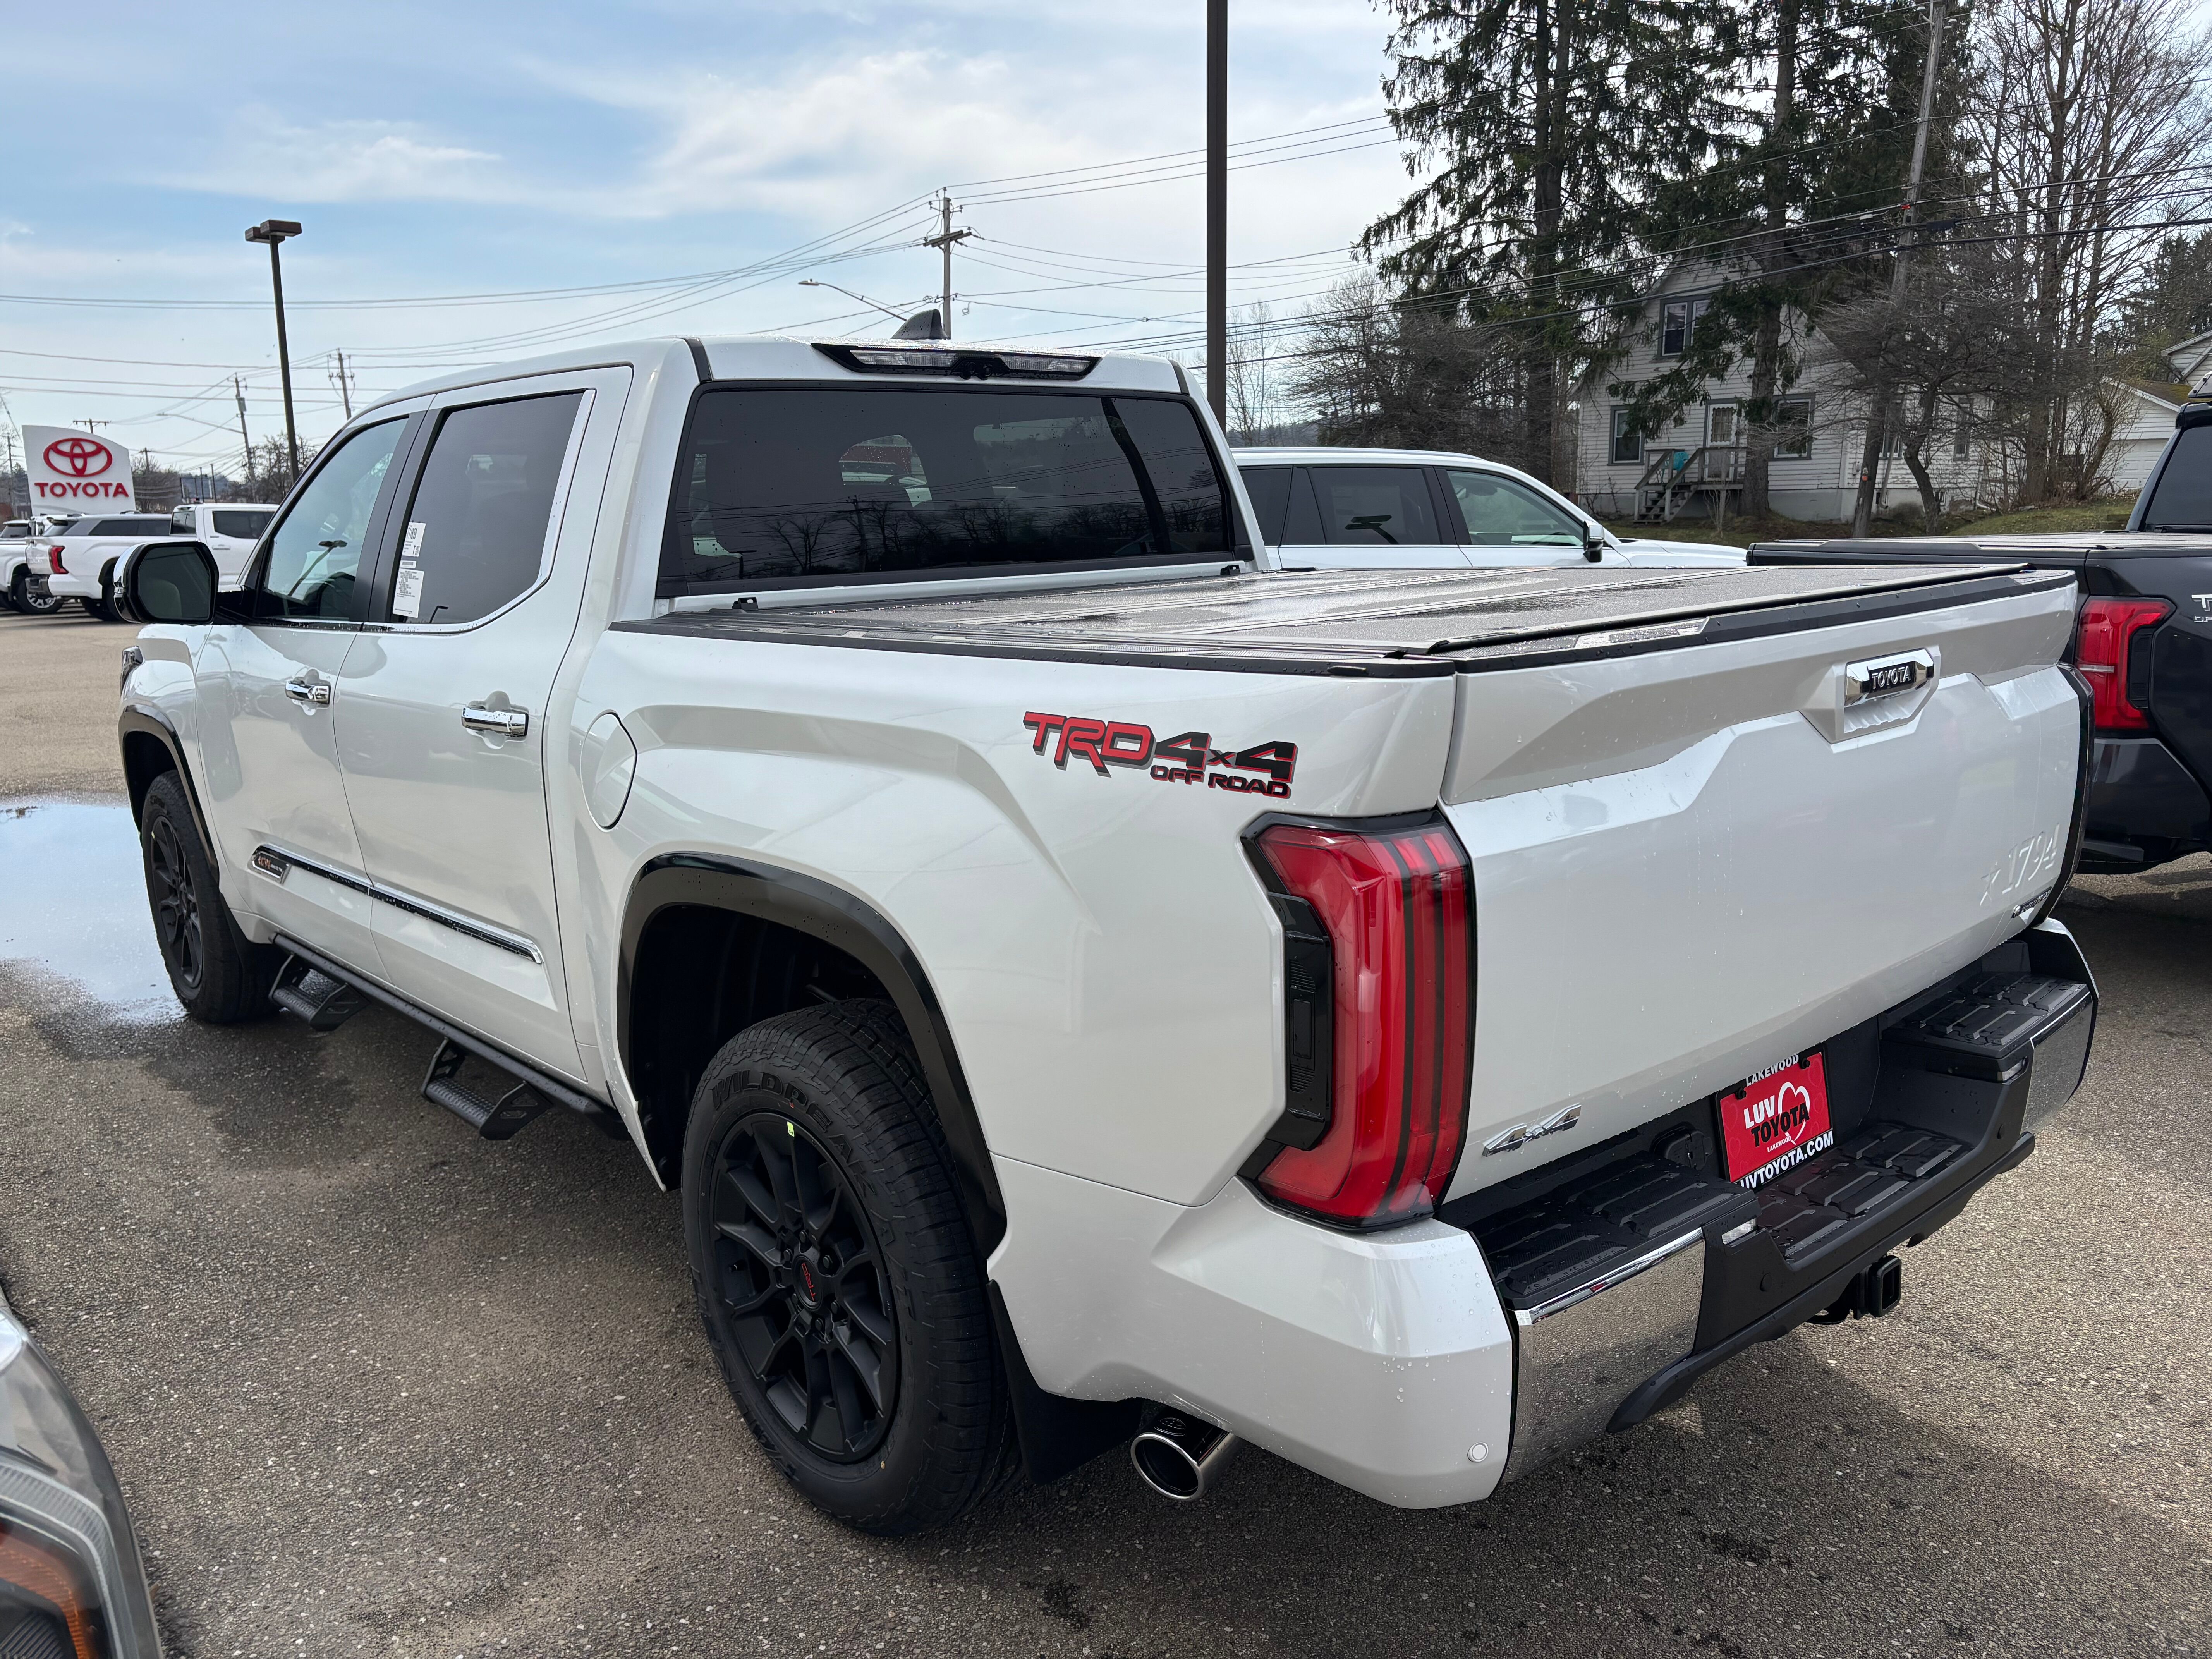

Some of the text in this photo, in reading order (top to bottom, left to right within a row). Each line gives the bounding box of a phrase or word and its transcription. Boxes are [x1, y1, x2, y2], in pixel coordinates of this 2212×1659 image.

[34, 482, 129, 498] TOYOTA
[1872, 666, 1911, 689] TOYOTA
[1023, 711, 1157, 778] TRD
[1150, 765, 1291, 799] OFF ROAD
[2002, 823, 2060, 894] 1794
[1746, 1053, 1799, 1087] LAKEWOOD
[1744, 1095, 1775, 1129] LUV
[1751, 1102, 1810, 1147] TOYOTA
[712, 1070, 877, 1197] WILDPEAK
[1767, 1135, 1791, 1153] LAKEWOOD
[1735, 1130, 1834, 1189] UVTOYOTA.COM
